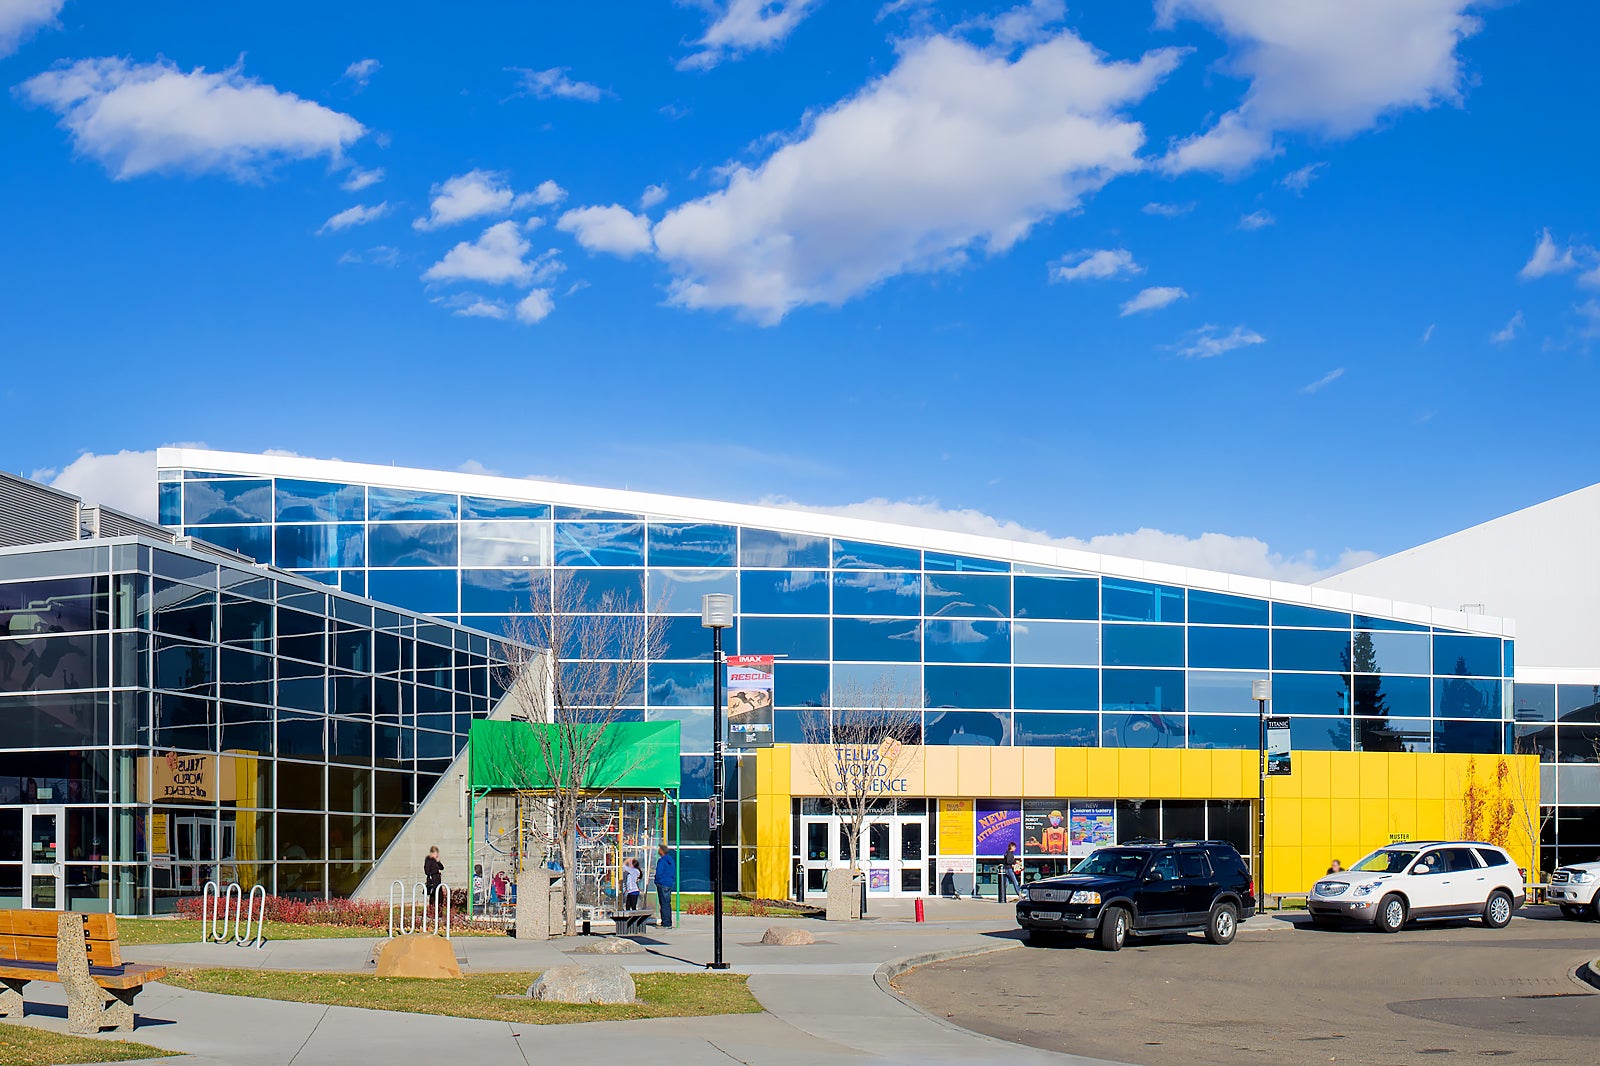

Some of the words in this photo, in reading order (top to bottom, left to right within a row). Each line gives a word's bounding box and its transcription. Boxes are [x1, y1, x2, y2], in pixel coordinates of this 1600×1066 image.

[835, 748, 879, 761] TELUS
[835, 764, 887, 776] WORLD
[852, 779, 907, 791] SCIENCE
[978, 809, 1008, 829] NEW
[976, 817, 1021, 843] ATTRACTIONS!
